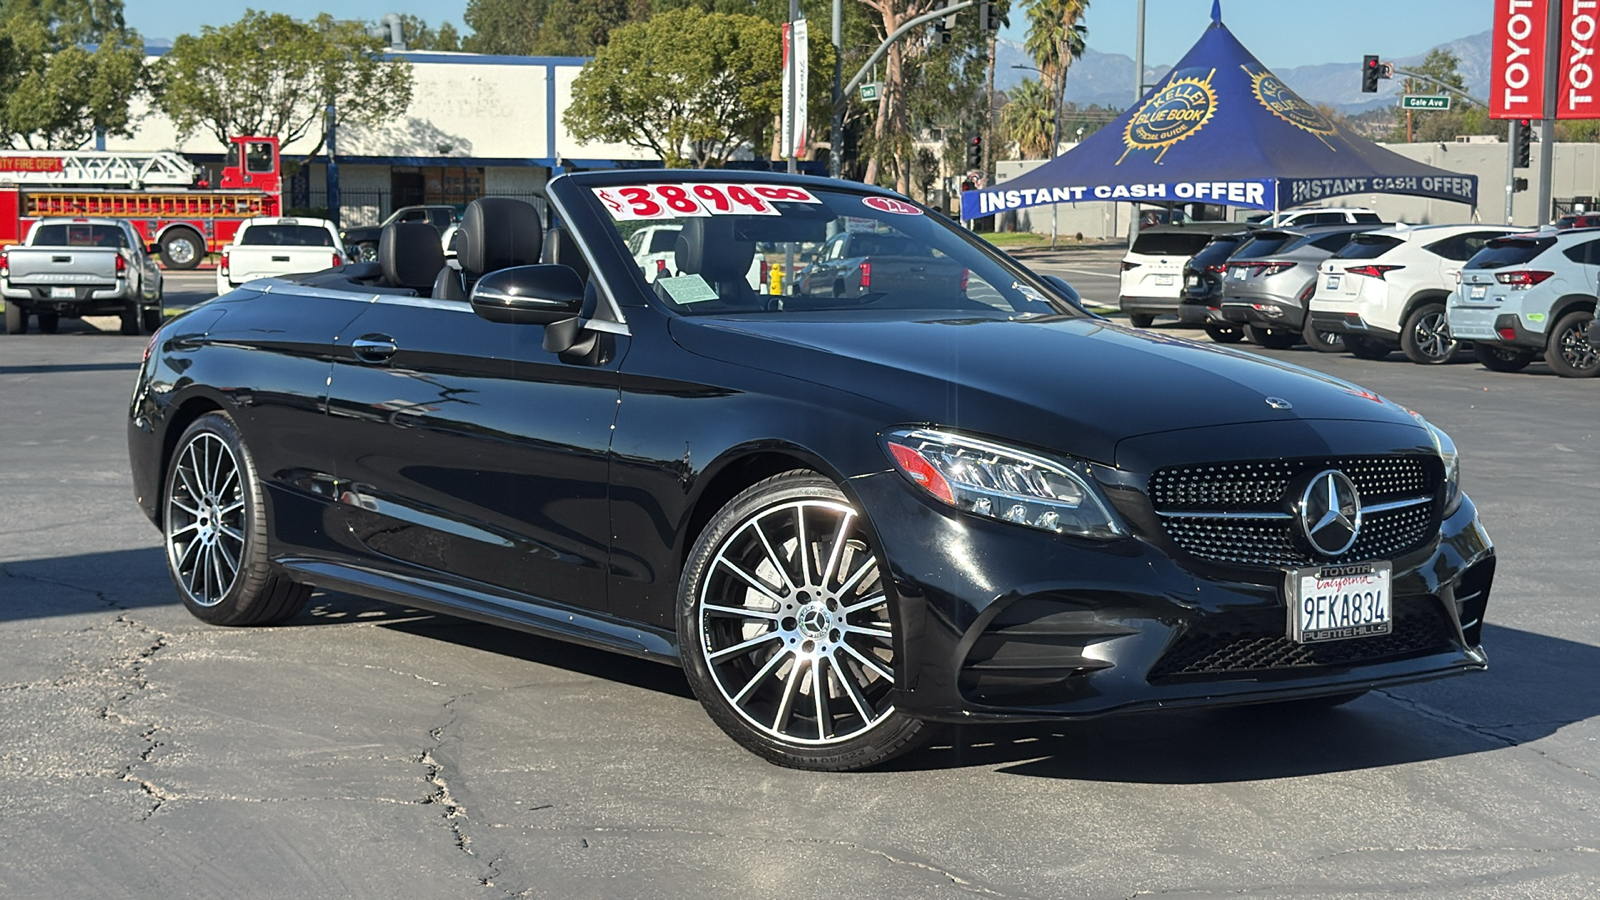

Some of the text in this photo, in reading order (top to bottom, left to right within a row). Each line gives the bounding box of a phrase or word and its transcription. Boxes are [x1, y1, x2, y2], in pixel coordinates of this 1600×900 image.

[1153, 87, 1207, 108] KELLEY
[1410, 98, 1443, 107] Gale Ave
[1135, 109, 1205, 125] BLUE BOOK
[1161, 124, 1188, 139] GUIDE
[15, 158, 35, 170] FIRE
[979, 182, 1265, 214] INSTANT CASH OFFER
[1292, 177, 1473, 202] INSTANT CASH OFFER
[1322, 565, 1371, 577] TOYOTA
[1316, 575, 1374, 592] California
[1304, 590, 1385, 630] 9FKA834
[1303, 624, 1388, 642] PUENTE HILLS
